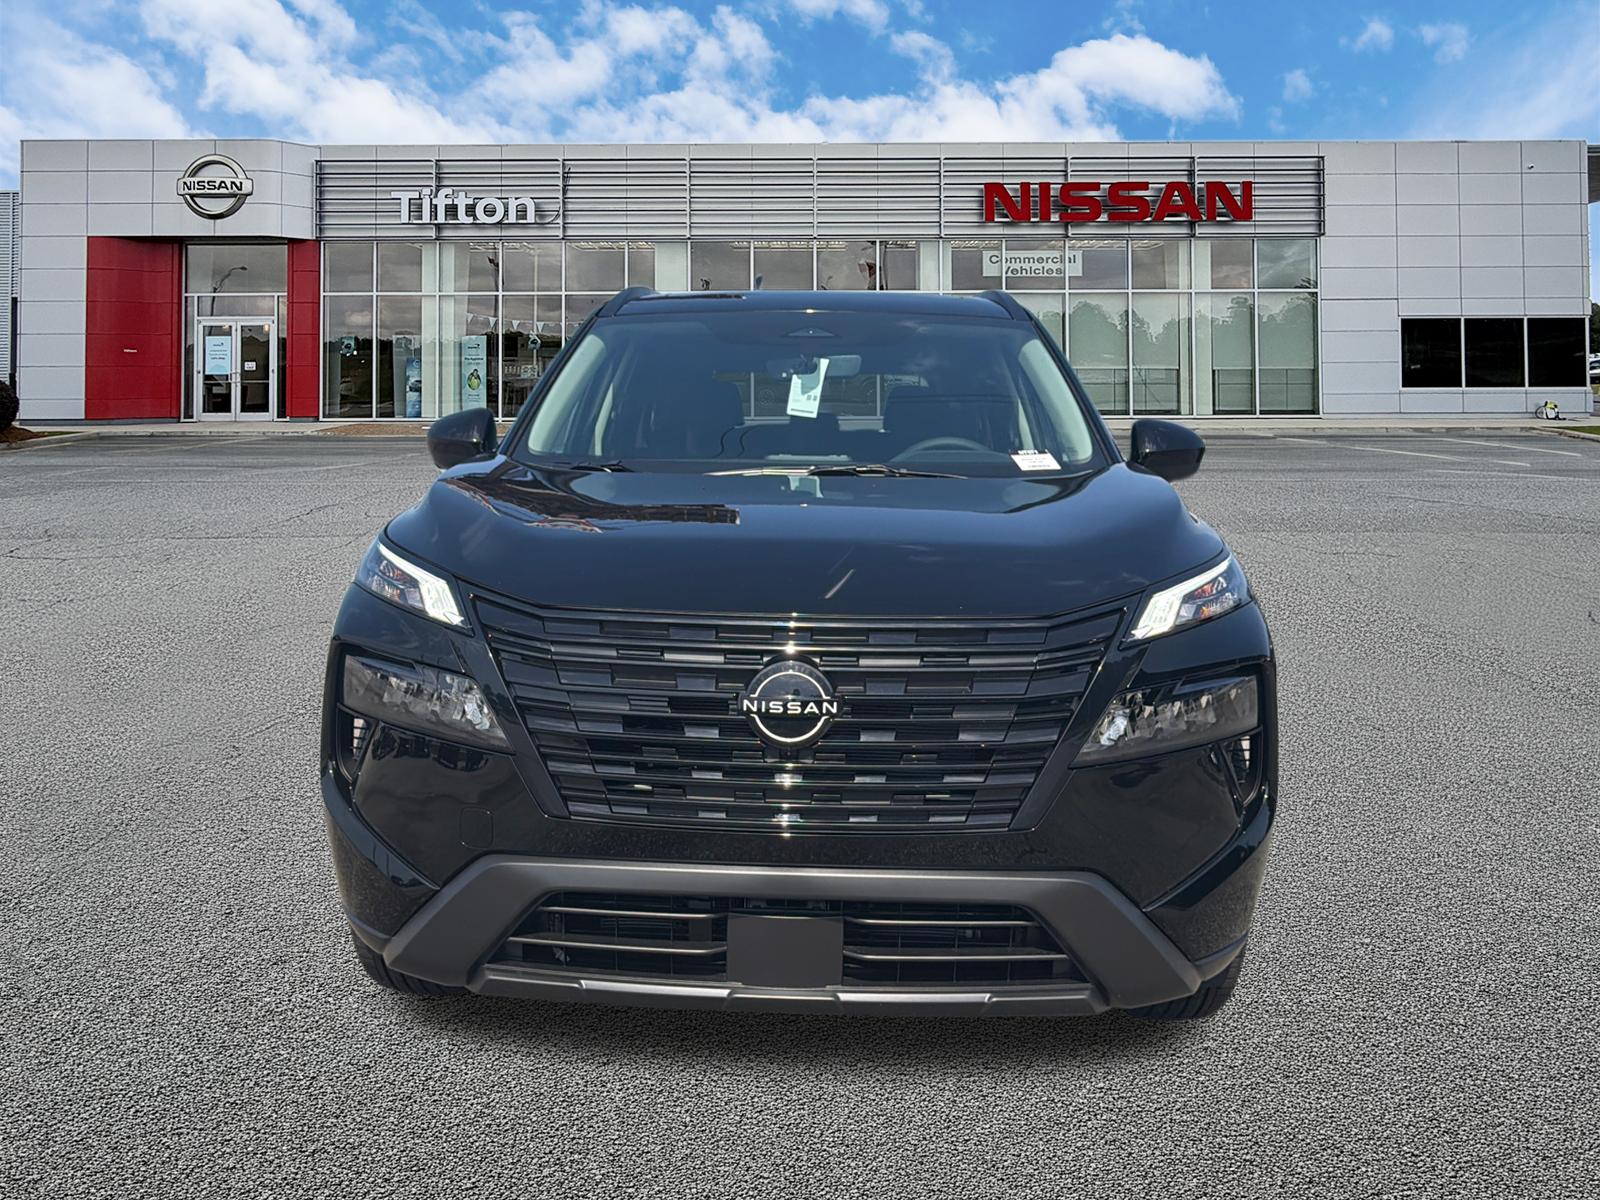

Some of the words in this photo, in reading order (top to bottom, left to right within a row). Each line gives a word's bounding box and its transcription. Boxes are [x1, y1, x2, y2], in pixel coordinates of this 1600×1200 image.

[183, 180, 243, 191] NISSAN
[391, 187, 536, 224] Tifton
[983, 181, 1253, 222] NISSAN
[743, 699, 837, 714] NISSAN
